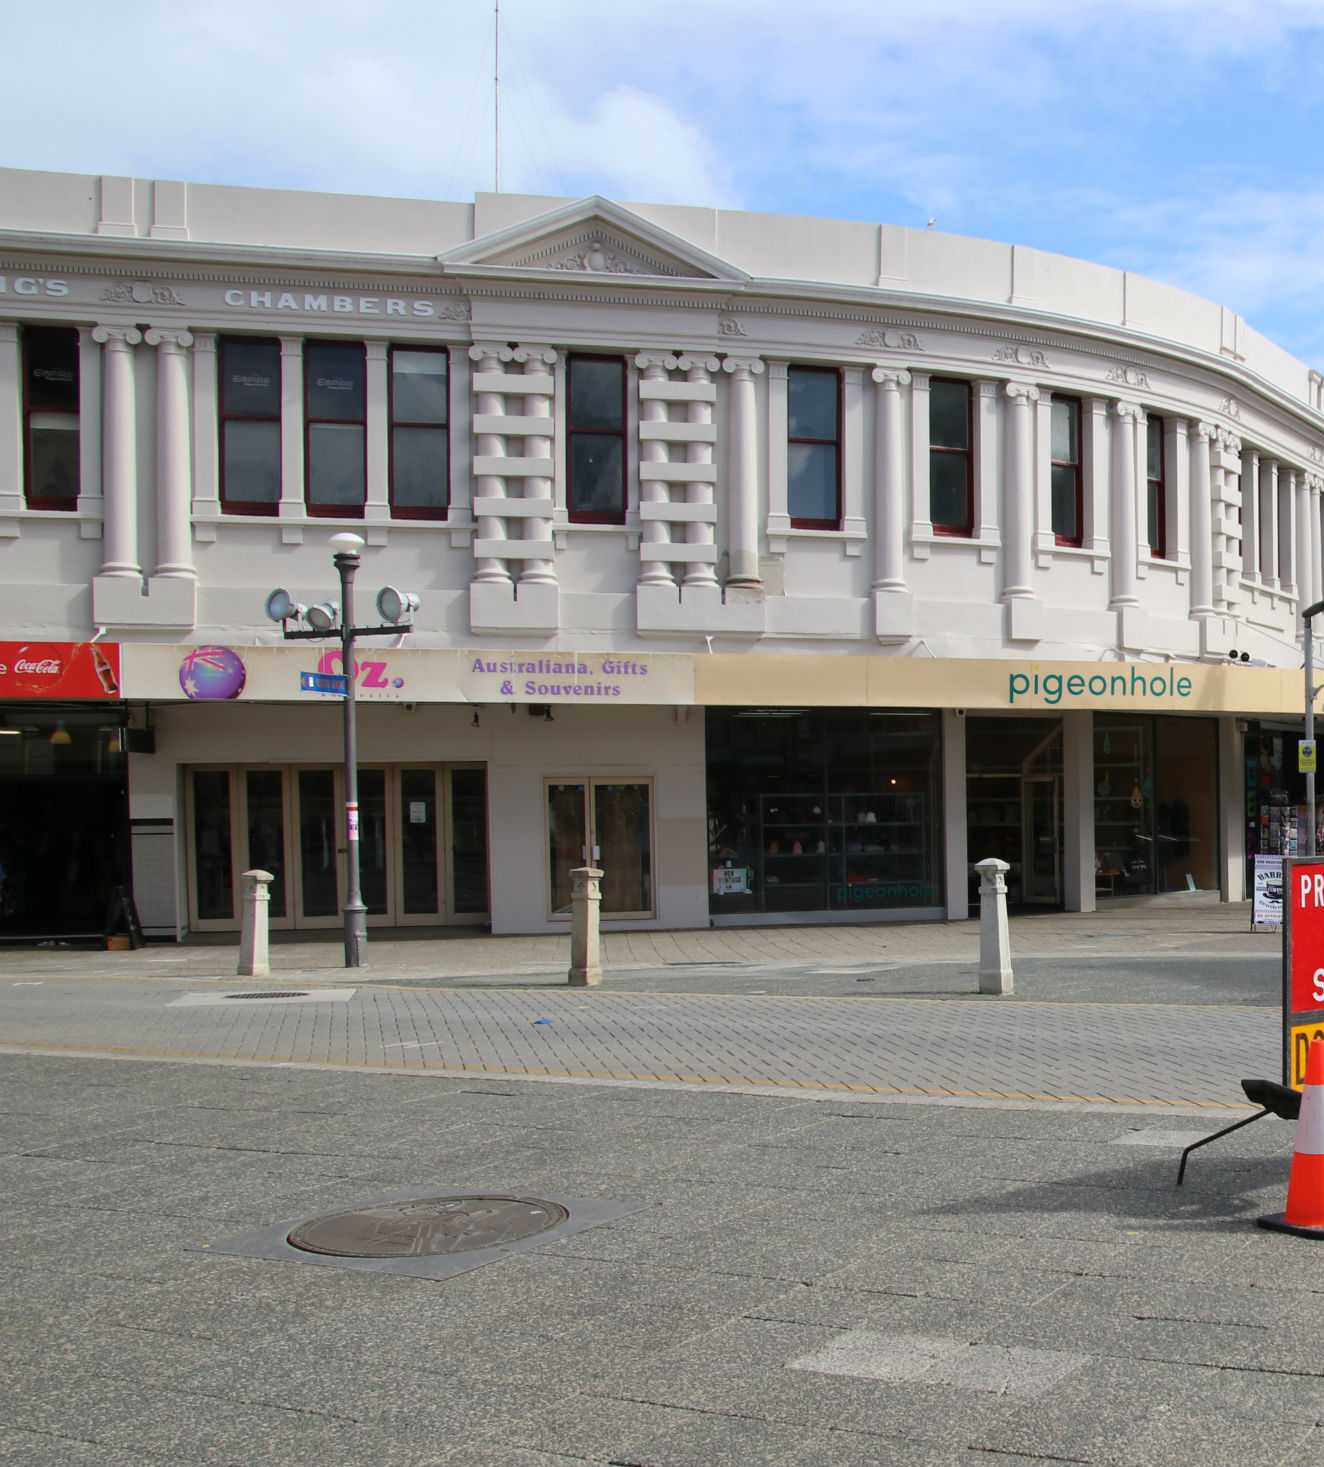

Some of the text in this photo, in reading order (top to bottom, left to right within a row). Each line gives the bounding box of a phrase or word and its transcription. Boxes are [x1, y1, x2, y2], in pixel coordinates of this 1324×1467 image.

[224, 289, 434, 317] CHAMBERS
[602, 659, 648, 676] Gifts
[500, 680, 622, 697] & Souvenirs
[1009, 664, 1192, 705] pigeonhole
